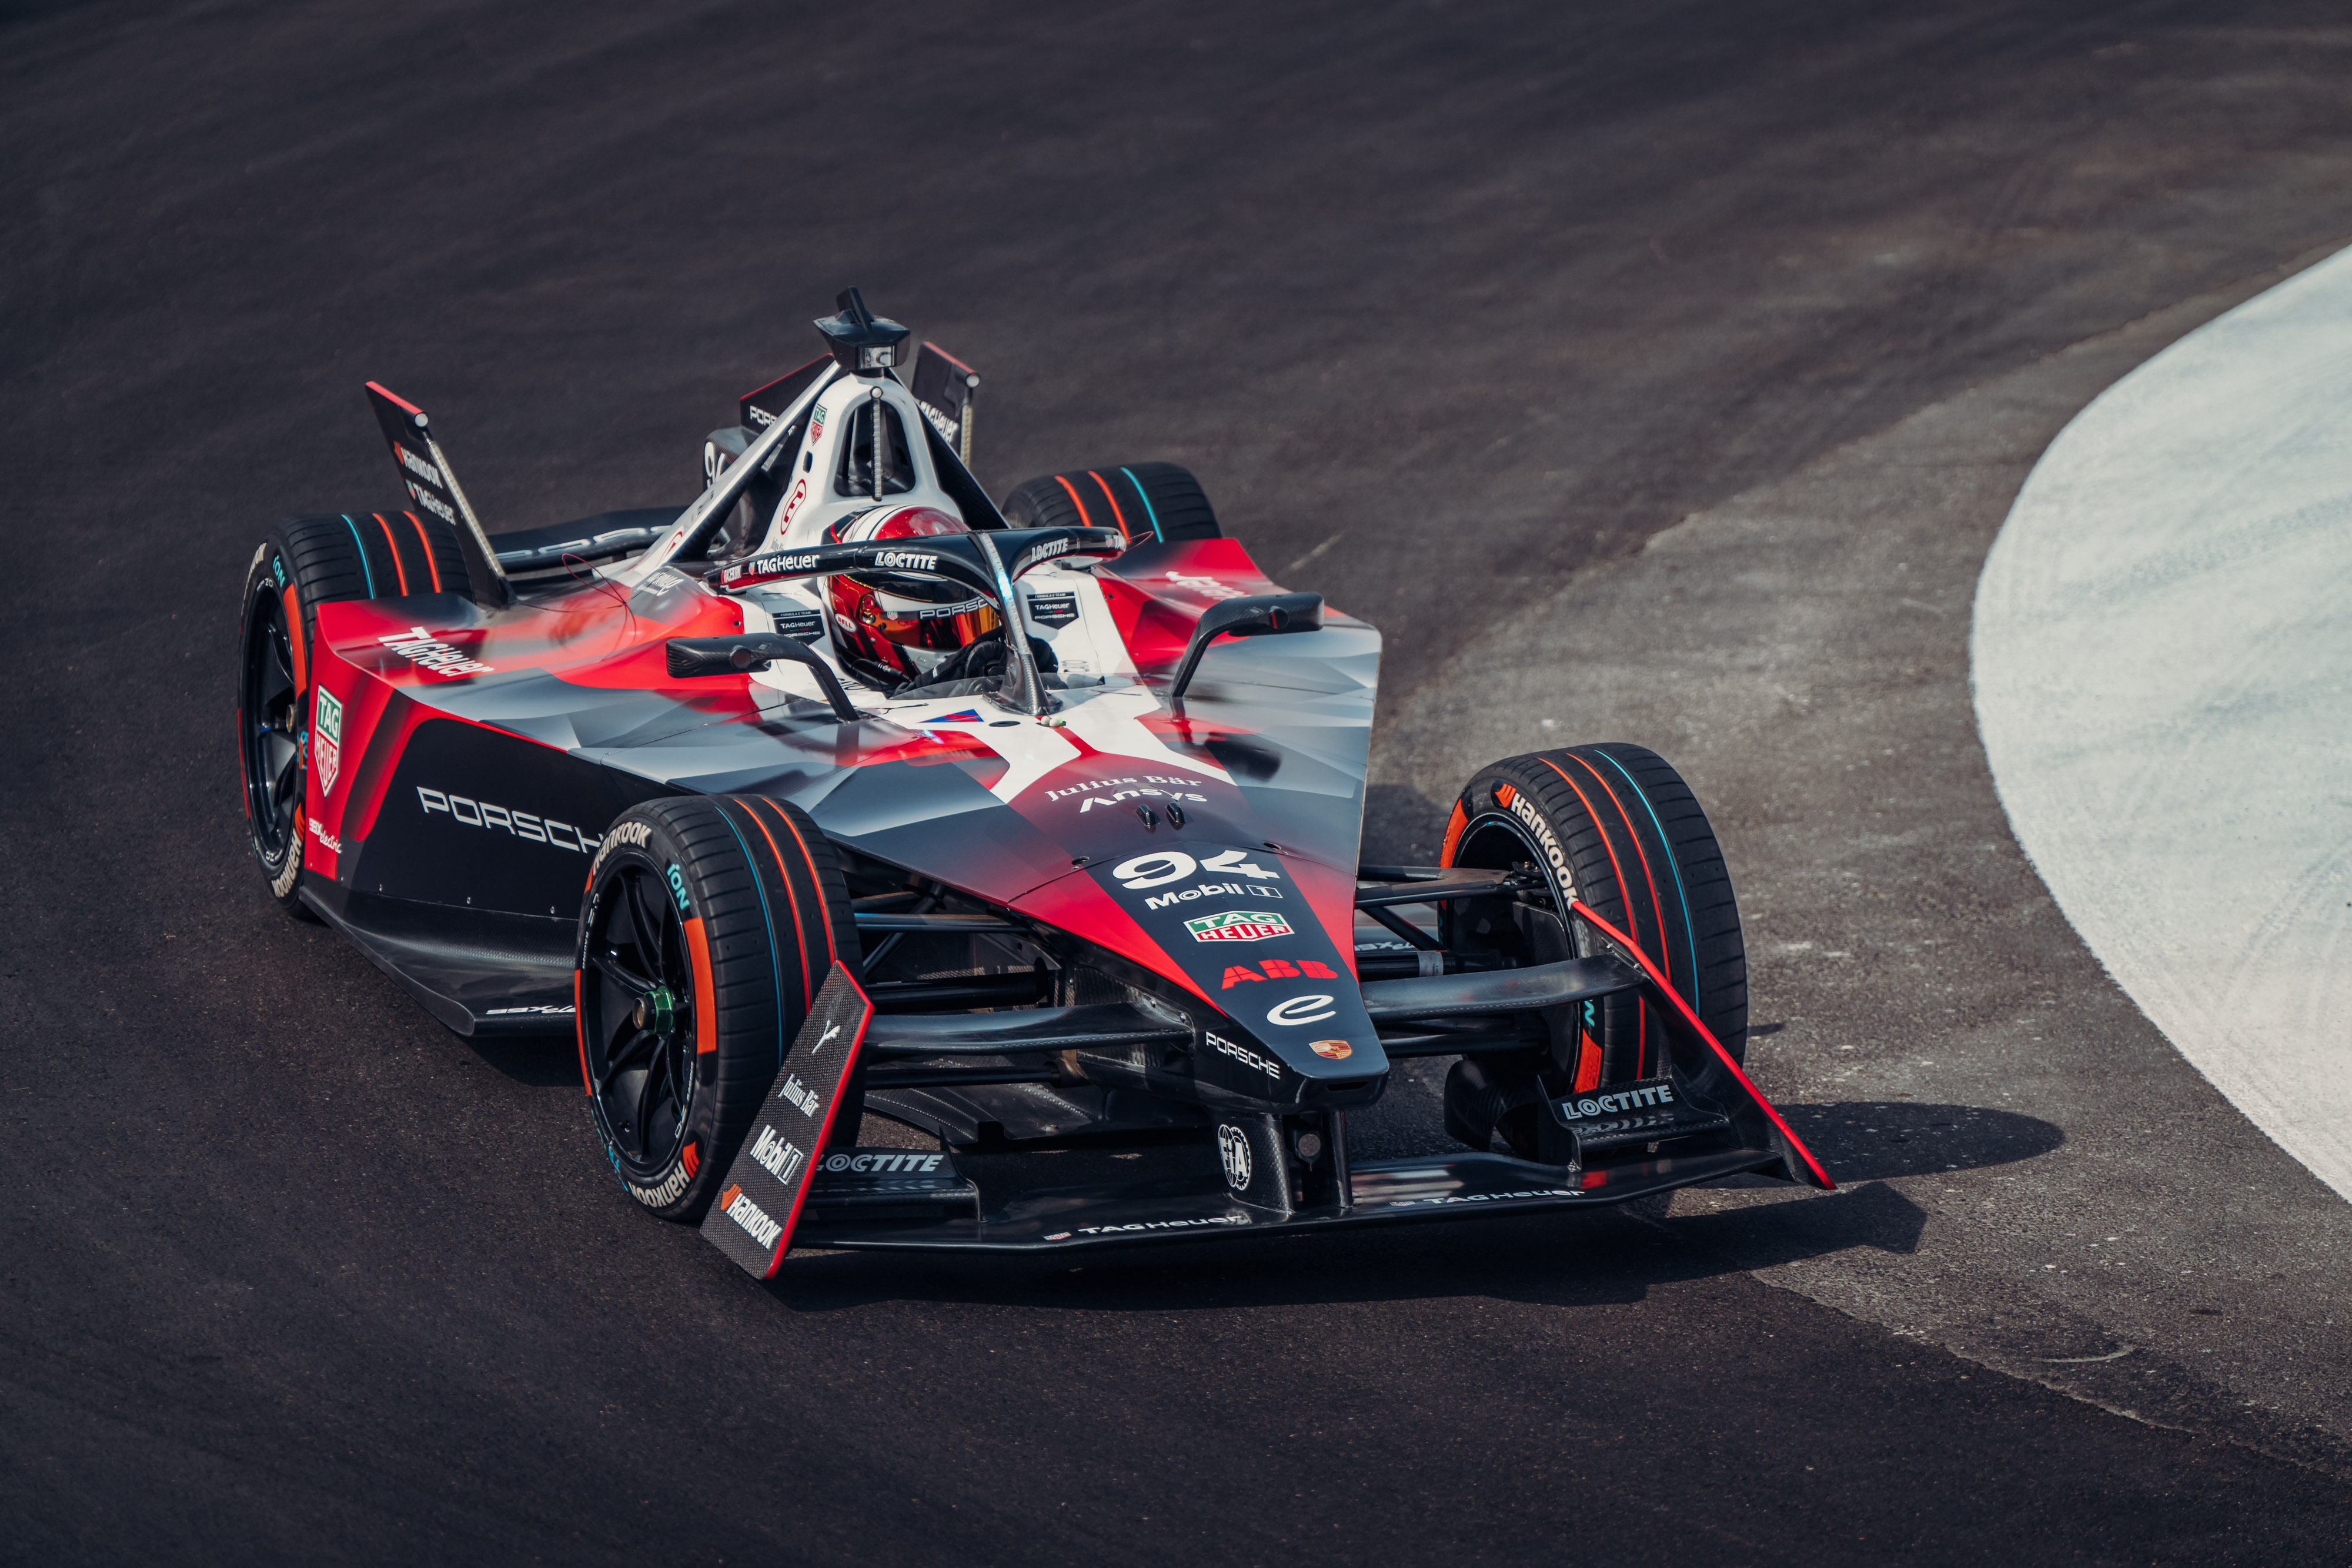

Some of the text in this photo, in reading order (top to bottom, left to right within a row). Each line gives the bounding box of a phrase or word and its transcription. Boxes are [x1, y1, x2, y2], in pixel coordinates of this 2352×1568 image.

[750, 405, 778, 427] PORS
[814, 407, 825, 423] TAG
[874, 551, 938, 570] LOCTITE
[1031, 537, 1068, 563] LOCTITE
[838, 616, 852, 628] BELL
[920, 599, 988, 619] PORSC
[319, 695, 339, 738] TAG
[316, 732, 337, 787] HEUER
[1044, 775, 1202, 801] Julius Bär
[1080, 788, 1208, 813] Ansys
[416, 786, 603, 854] PORSCH
[1112, 850, 1280, 890] 94
[1144, 882, 1245, 910] Mobil
[1194, 913, 1278, 928] TAG
[1200, 924, 1288, 940] HEUER
[1221, 959, 1338, 990] ABB
[1205, 1031, 1281, 1080] PORSCHE
[777, 1074, 820, 1117] Julius Bär
[1562, 1085, 1674, 1120] LOCTITE
[749, 1124, 794, 1176] Mobil
[1219, 1136, 1248, 1178] FIA
